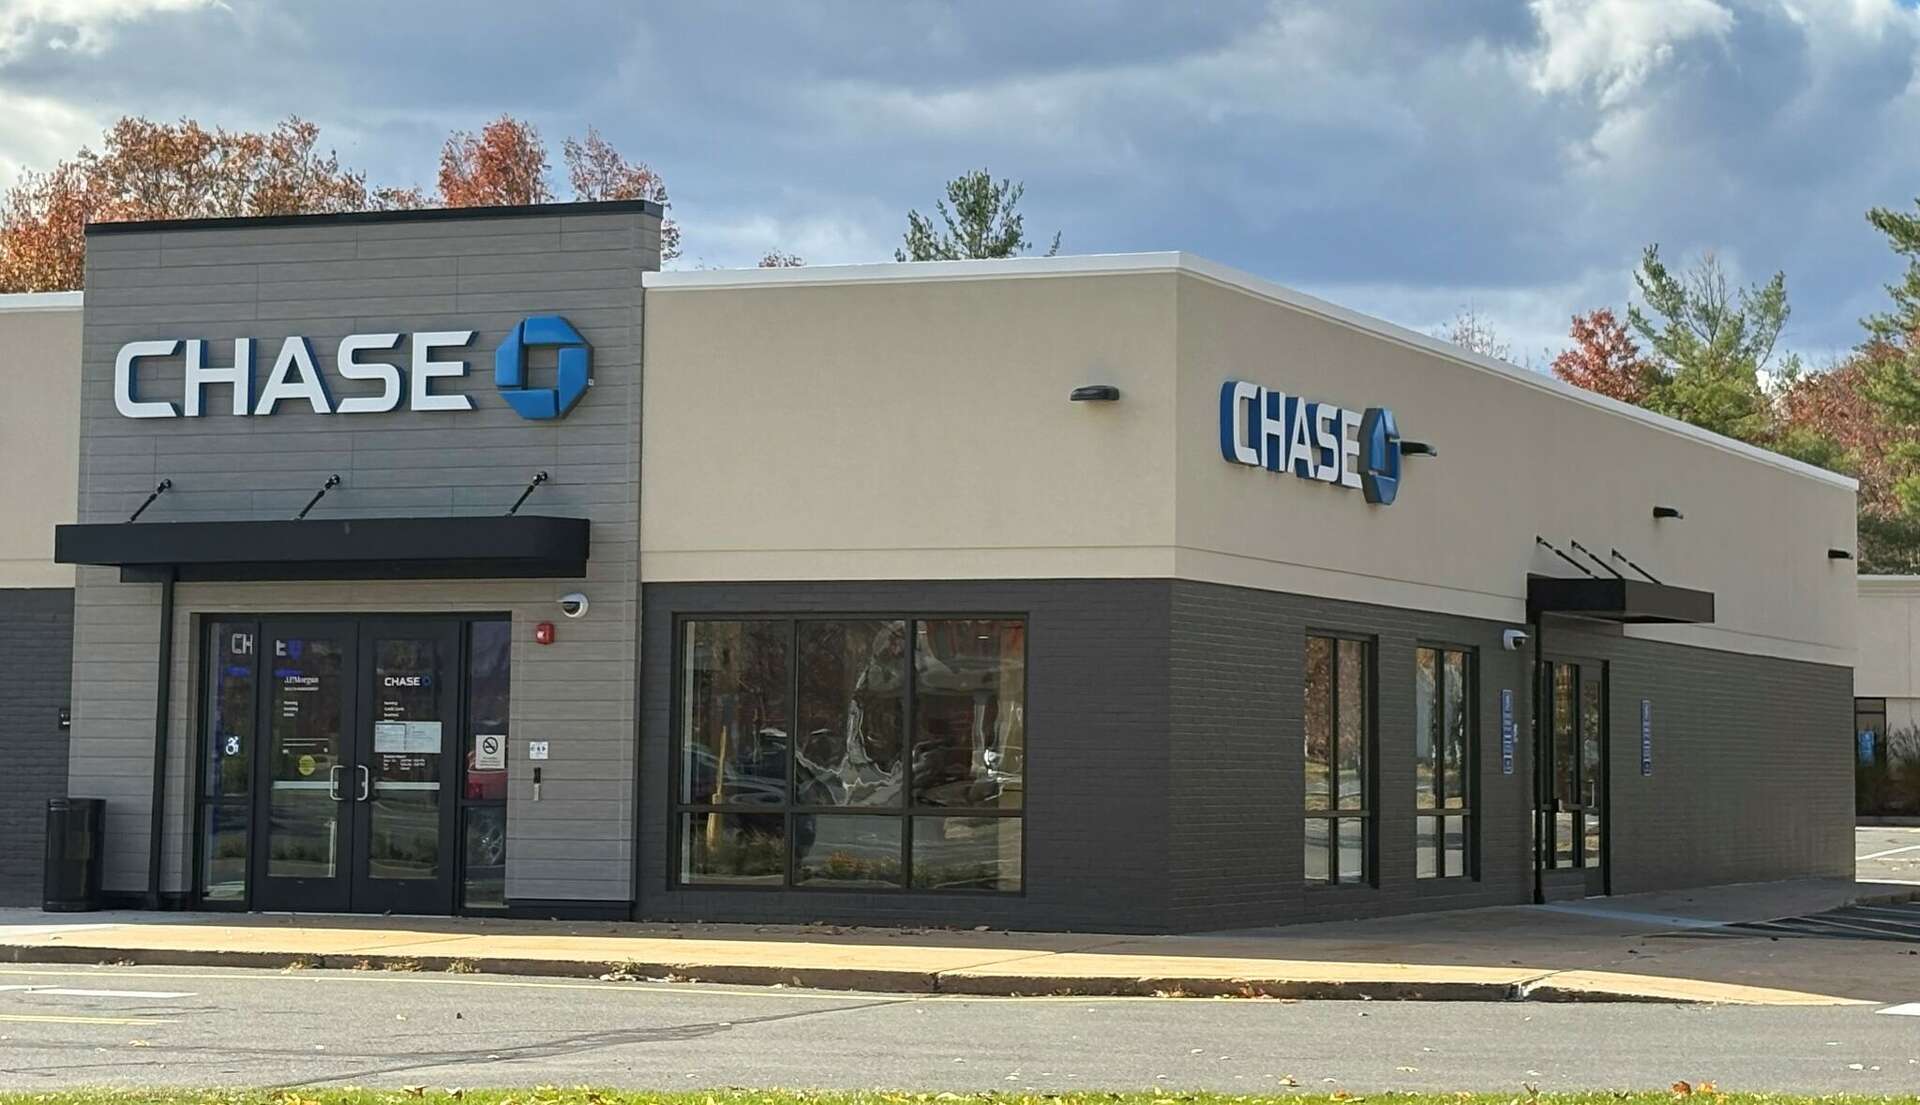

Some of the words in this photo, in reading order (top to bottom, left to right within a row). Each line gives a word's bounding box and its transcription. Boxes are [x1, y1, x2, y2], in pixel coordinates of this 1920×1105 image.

[114, 330, 476, 419] CHASE
[1220, 381, 1364, 490] CHASE
[384, 677, 421, 687] CHASE
